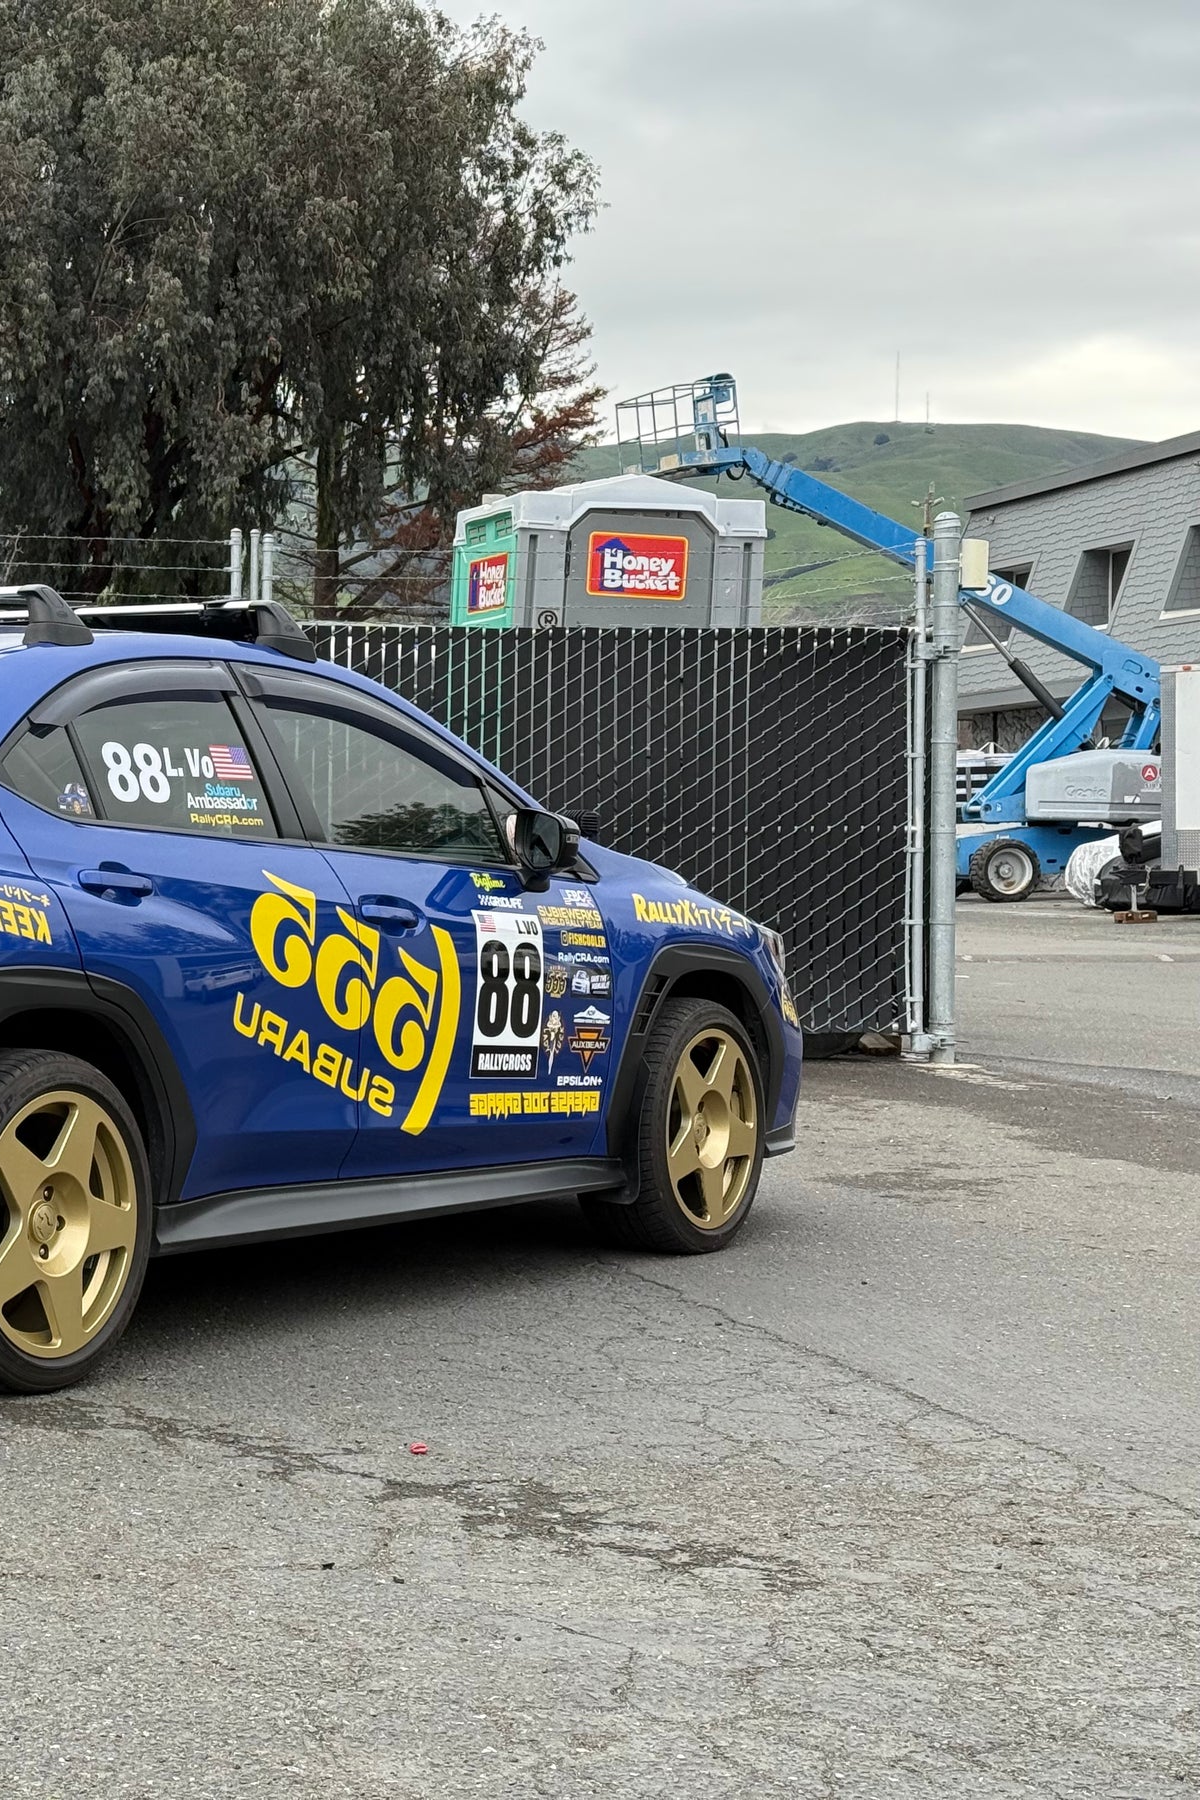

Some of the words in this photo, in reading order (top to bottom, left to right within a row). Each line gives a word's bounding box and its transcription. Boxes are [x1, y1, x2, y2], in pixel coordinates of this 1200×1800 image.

[604, 548, 675, 576] Honey
[479, 561, 505, 585] Honey
[603, 569, 680, 592] Bucket
[479, 580, 506, 608] Bucket
[101, 741, 171, 803] 88
[184, 748, 215, 779] Vo
[205, 783, 241, 797] Subaru
[187, 793, 258, 812] Ambassador
[190, 813, 264, 827] RallyCRA.com
[536, 905, 602, 922] SUBIEWERKS
[557, 952, 610, 964] RallyCRA.com
[477, 939, 541, 1039] 88
[571, 1040, 605, 1049] AUXBEAM
[477, 1053, 532, 1071] RALLYCROSS
[556, 1076, 603, 1087] EPSILON+
